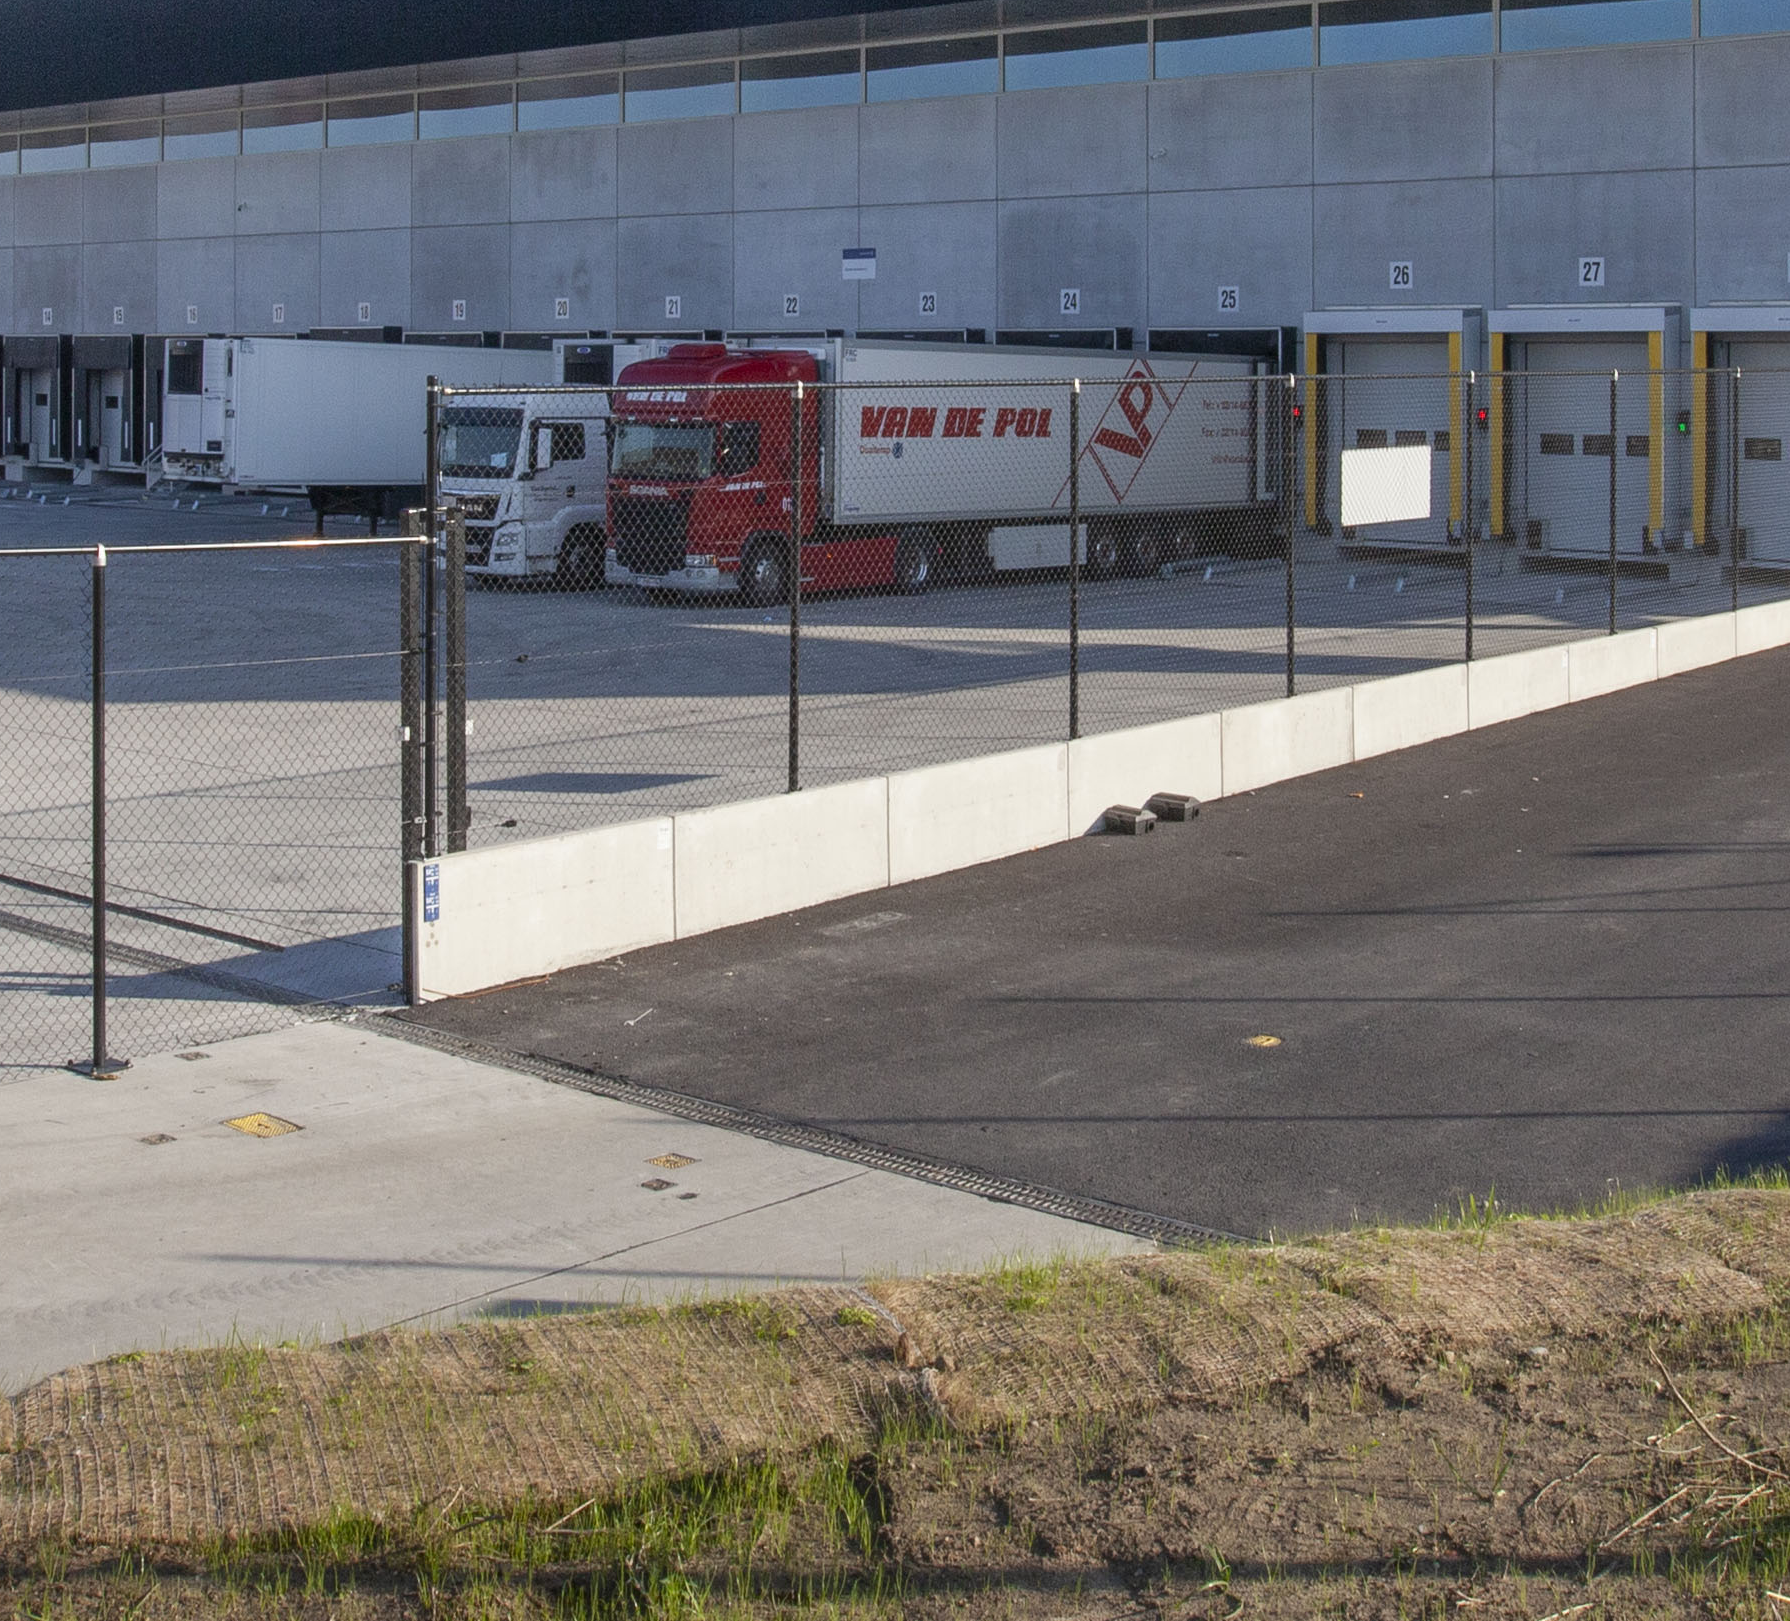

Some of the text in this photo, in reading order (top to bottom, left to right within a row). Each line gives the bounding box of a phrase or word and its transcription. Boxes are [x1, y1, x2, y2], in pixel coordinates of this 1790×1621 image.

[1393, 265, 1410, 286] 26
[1583, 261, 1601, 282] 27
[668, 298, 679, 315] 21
[785, 296, 798, 314] 22
[922, 294, 935, 313] 23
[1063, 291, 1078, 310] 24
[1221, 289, 1237, 309] 25
[274, 305, 284, 321] 17
[360, 304, 370, 319] 18
[454, 302, 464, 318] 19
[556, 300, 568, 317] 20
[860, 405, 1053, 438] VAN DE POL
[629, 484, 670, 496] SCANIA
